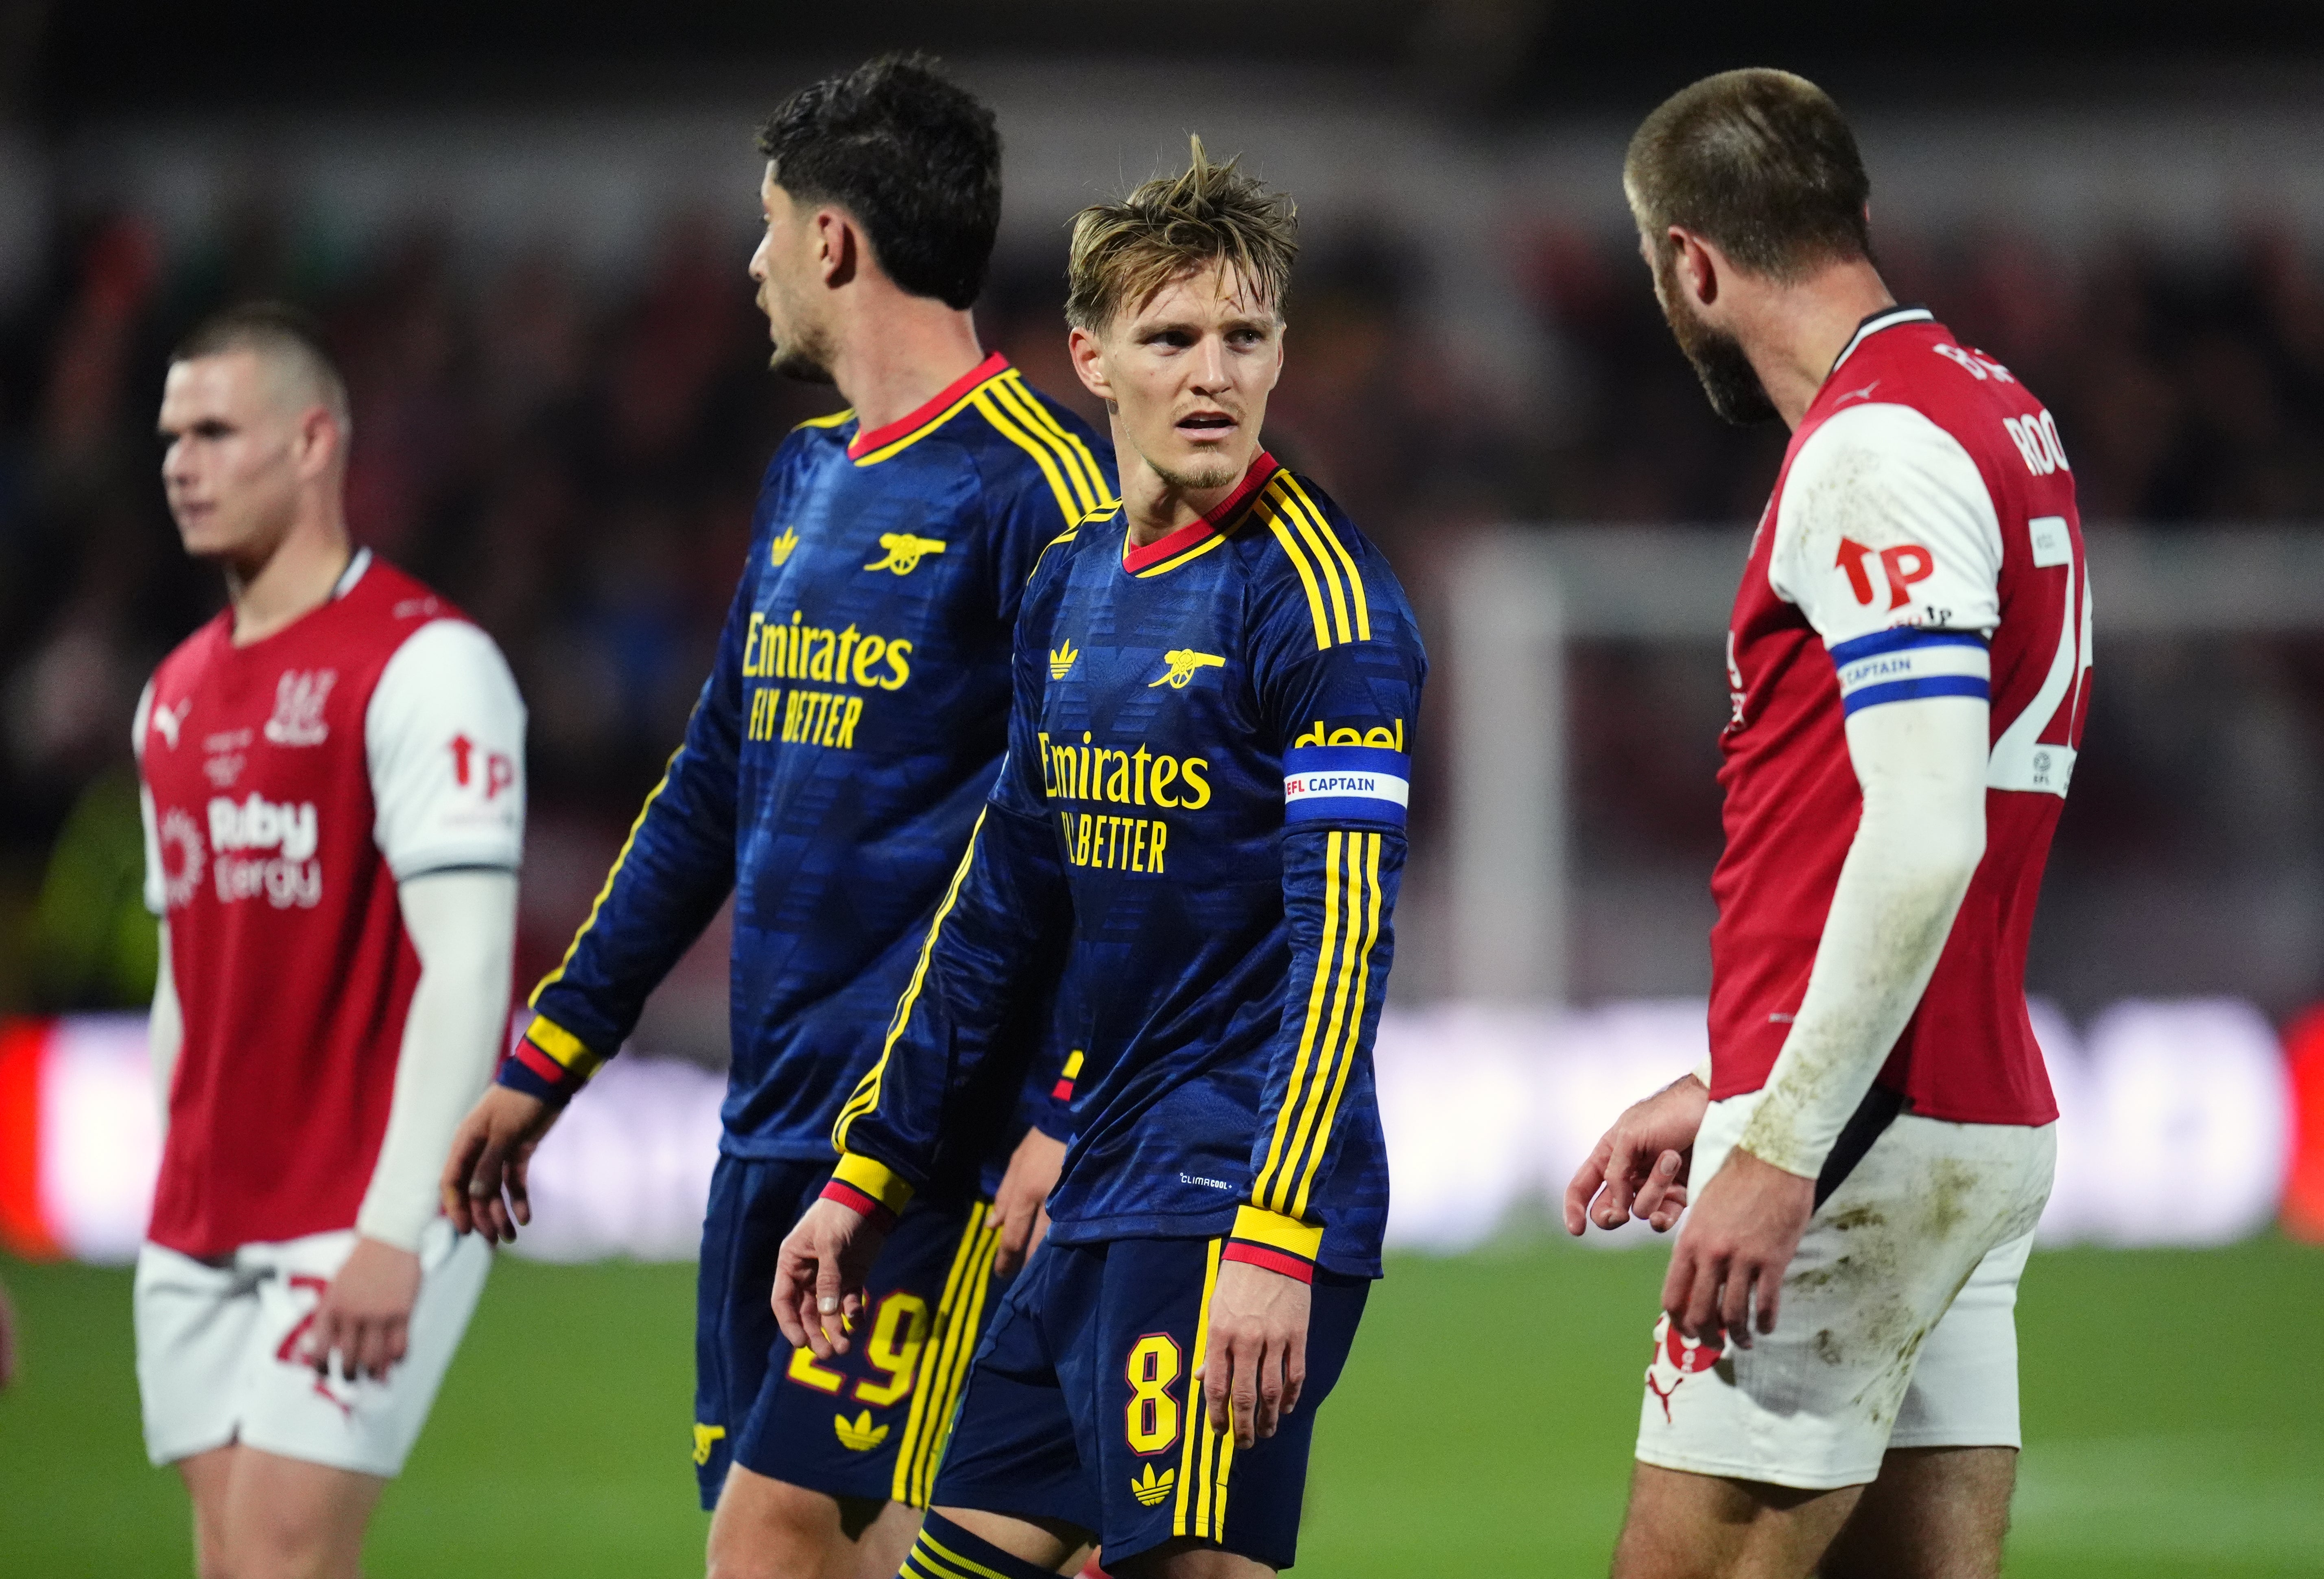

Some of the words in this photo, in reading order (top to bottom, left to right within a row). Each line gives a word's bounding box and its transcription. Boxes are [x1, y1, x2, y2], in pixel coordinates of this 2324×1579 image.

[743, 610, 913, 691] Emirates
[1846, 657, 1911, 685] CAPTAIN
[1988, 515, 2092, 799] 2
[781, 689, 863, 749] BETTER
[1038, 731, 1211, 809] Emirates
[1287, 780, 1304, 795] EFL
[1309, 778, 1374, 791] CAPTAIN
[1076, 814, 1166, 873] BETTER
[1125, 1332, 1182, 1456] 8
